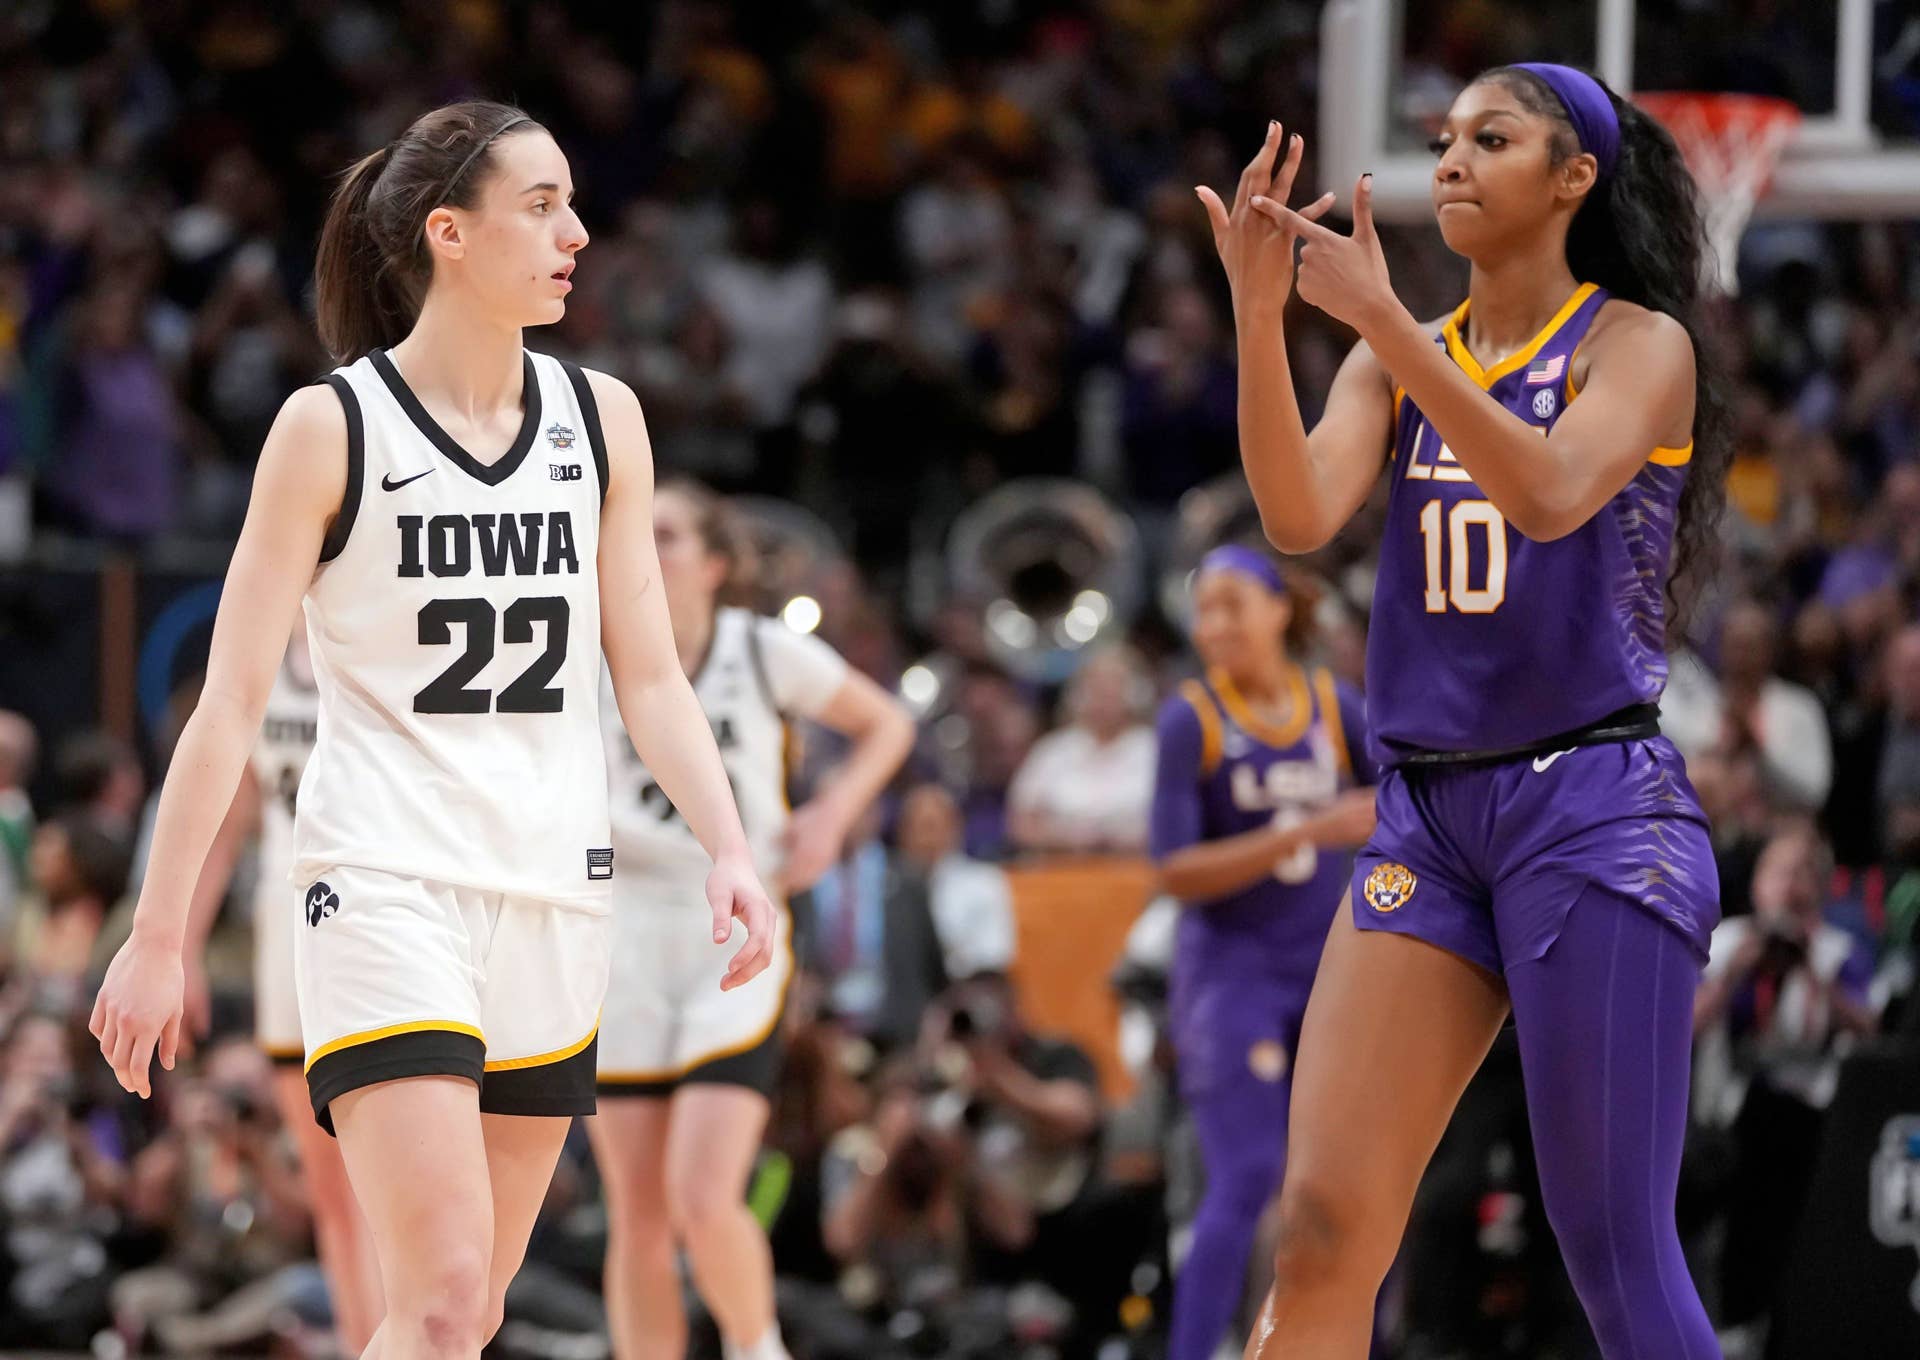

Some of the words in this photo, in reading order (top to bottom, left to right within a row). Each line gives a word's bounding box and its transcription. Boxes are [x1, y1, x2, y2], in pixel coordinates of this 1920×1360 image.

[1534, 391, 1554, 416] SEC
[397, 512, 579, 577] IOWA
[1420, 499, 1508, 614] 10
[413, 596, 570, 714] 22
